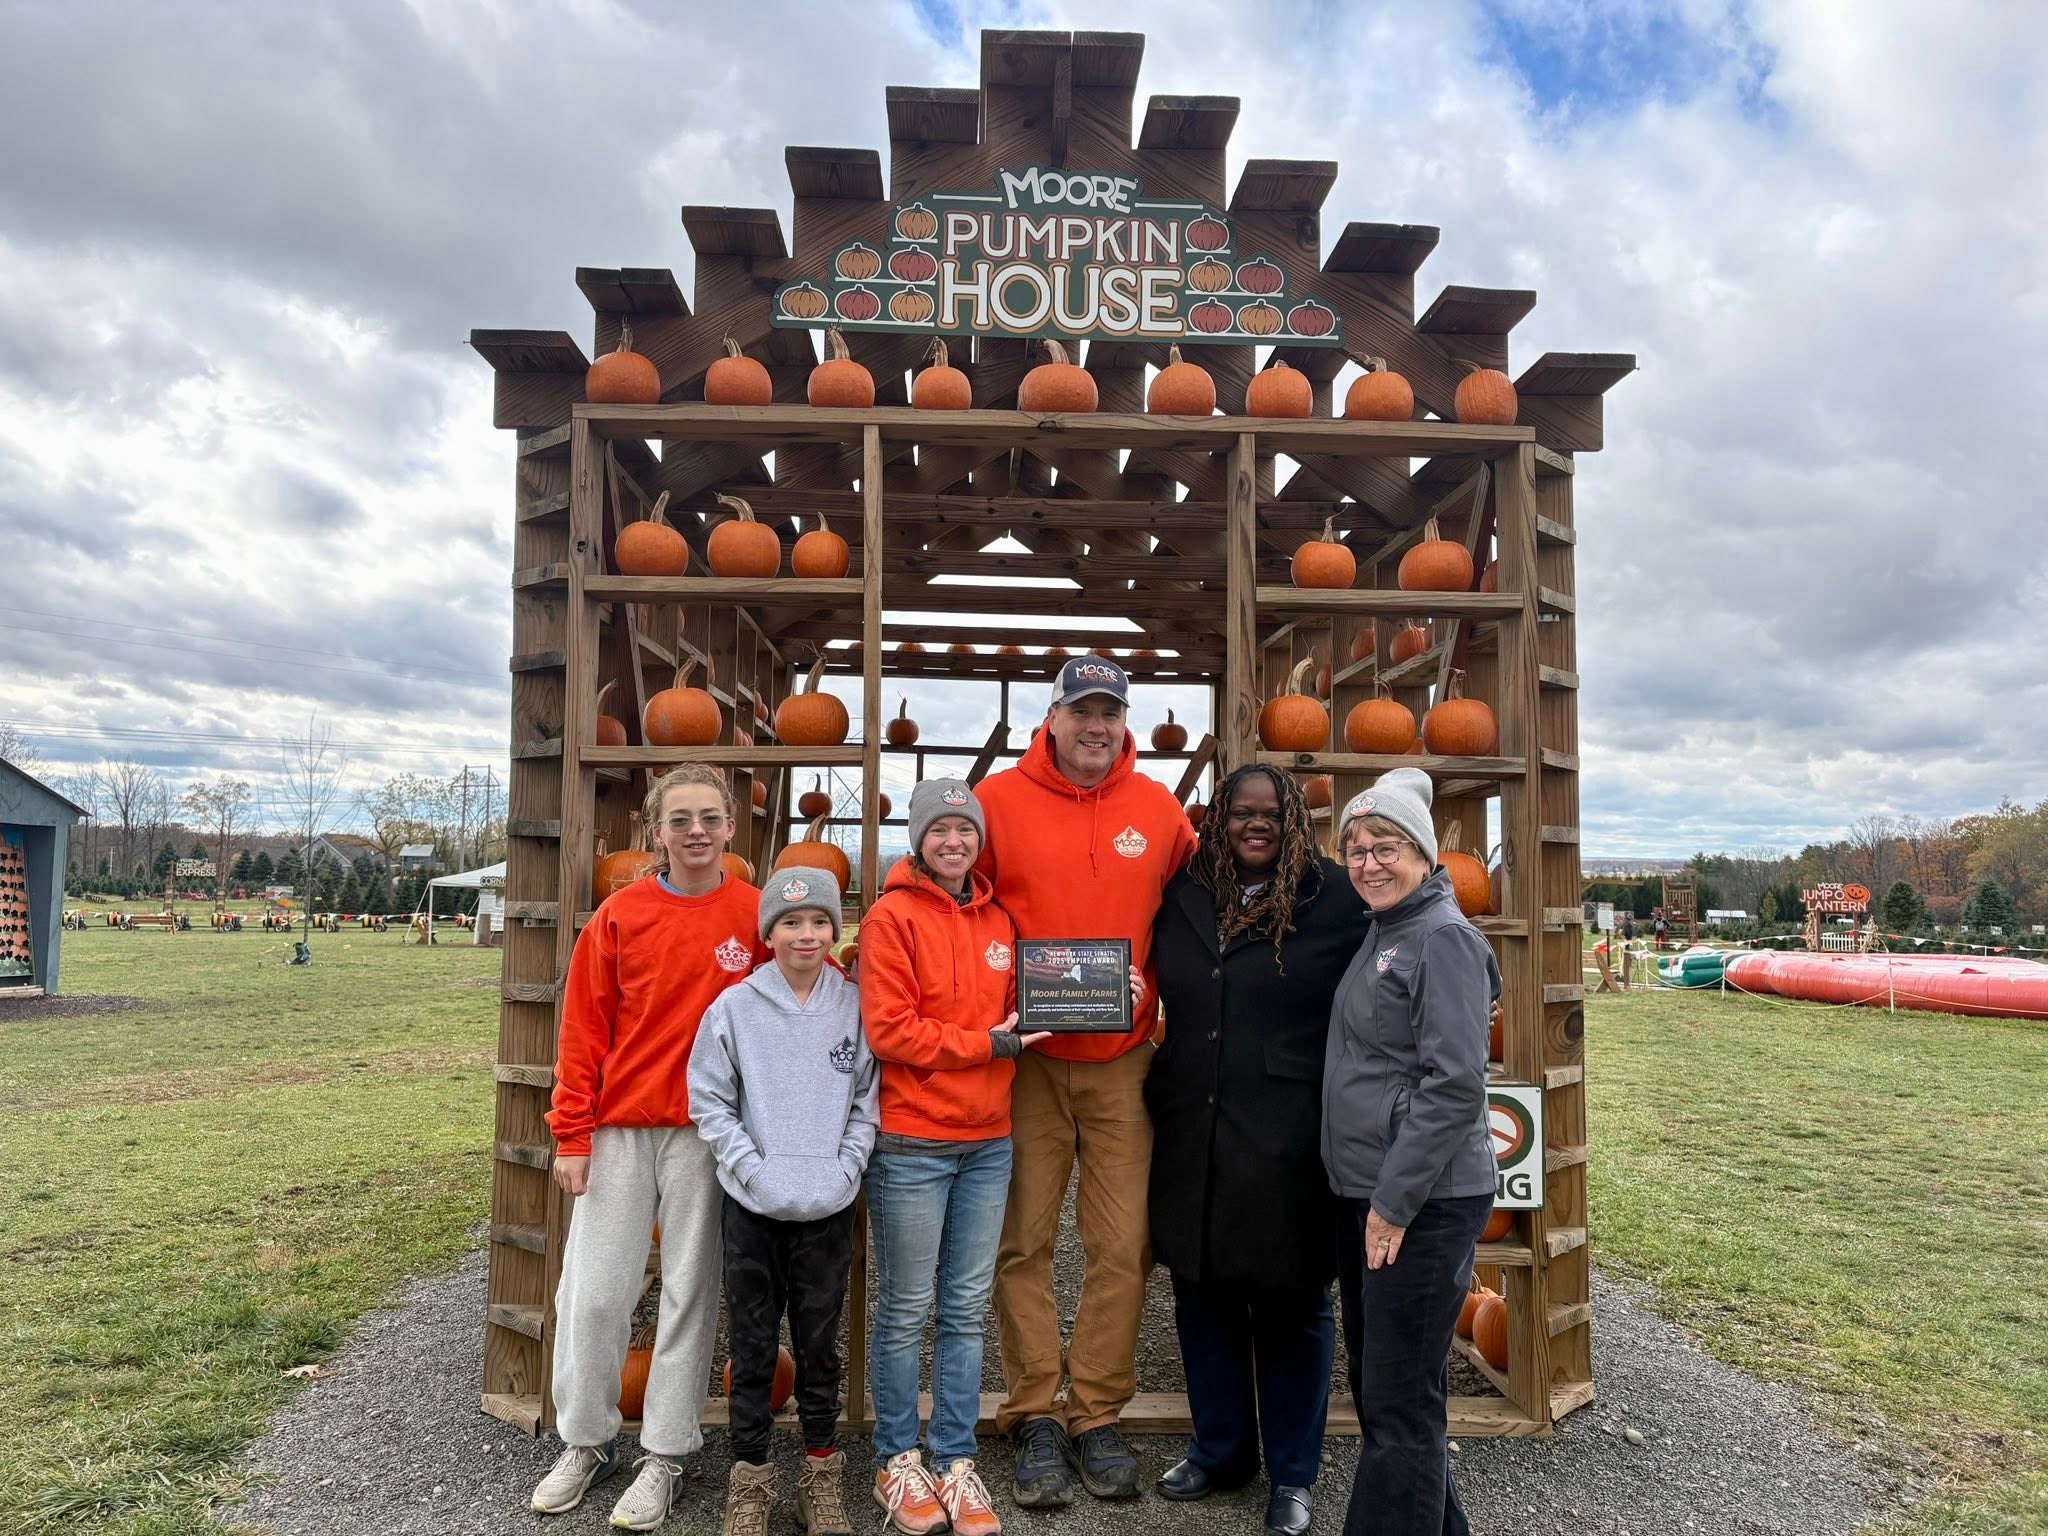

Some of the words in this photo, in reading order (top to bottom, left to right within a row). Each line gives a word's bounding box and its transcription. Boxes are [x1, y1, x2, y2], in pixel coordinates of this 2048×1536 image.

[1001, 167, 1137, 213] MOORE
[945, 212, 1179, 264] PUMPKIN
[940, 261, 1186, 334] HOUSE
[1075, 664, 1118, 682] MOORE
[1115, 838, 1146, 848] MOORE
[176, 868, 216, 876] EXPRESS
[1800, 890, 1832, 902] JUMP
[1834, 890, 1845, 900] O
[1807, 901, 1866, 911] LANTERN
[715, 948, 752, 964] MOORE
[1061, 989, 1089, 997] FAMILY
[1090, 989, 1118, 997] FARMS
[829, 1050, 855, 1063] MOO
